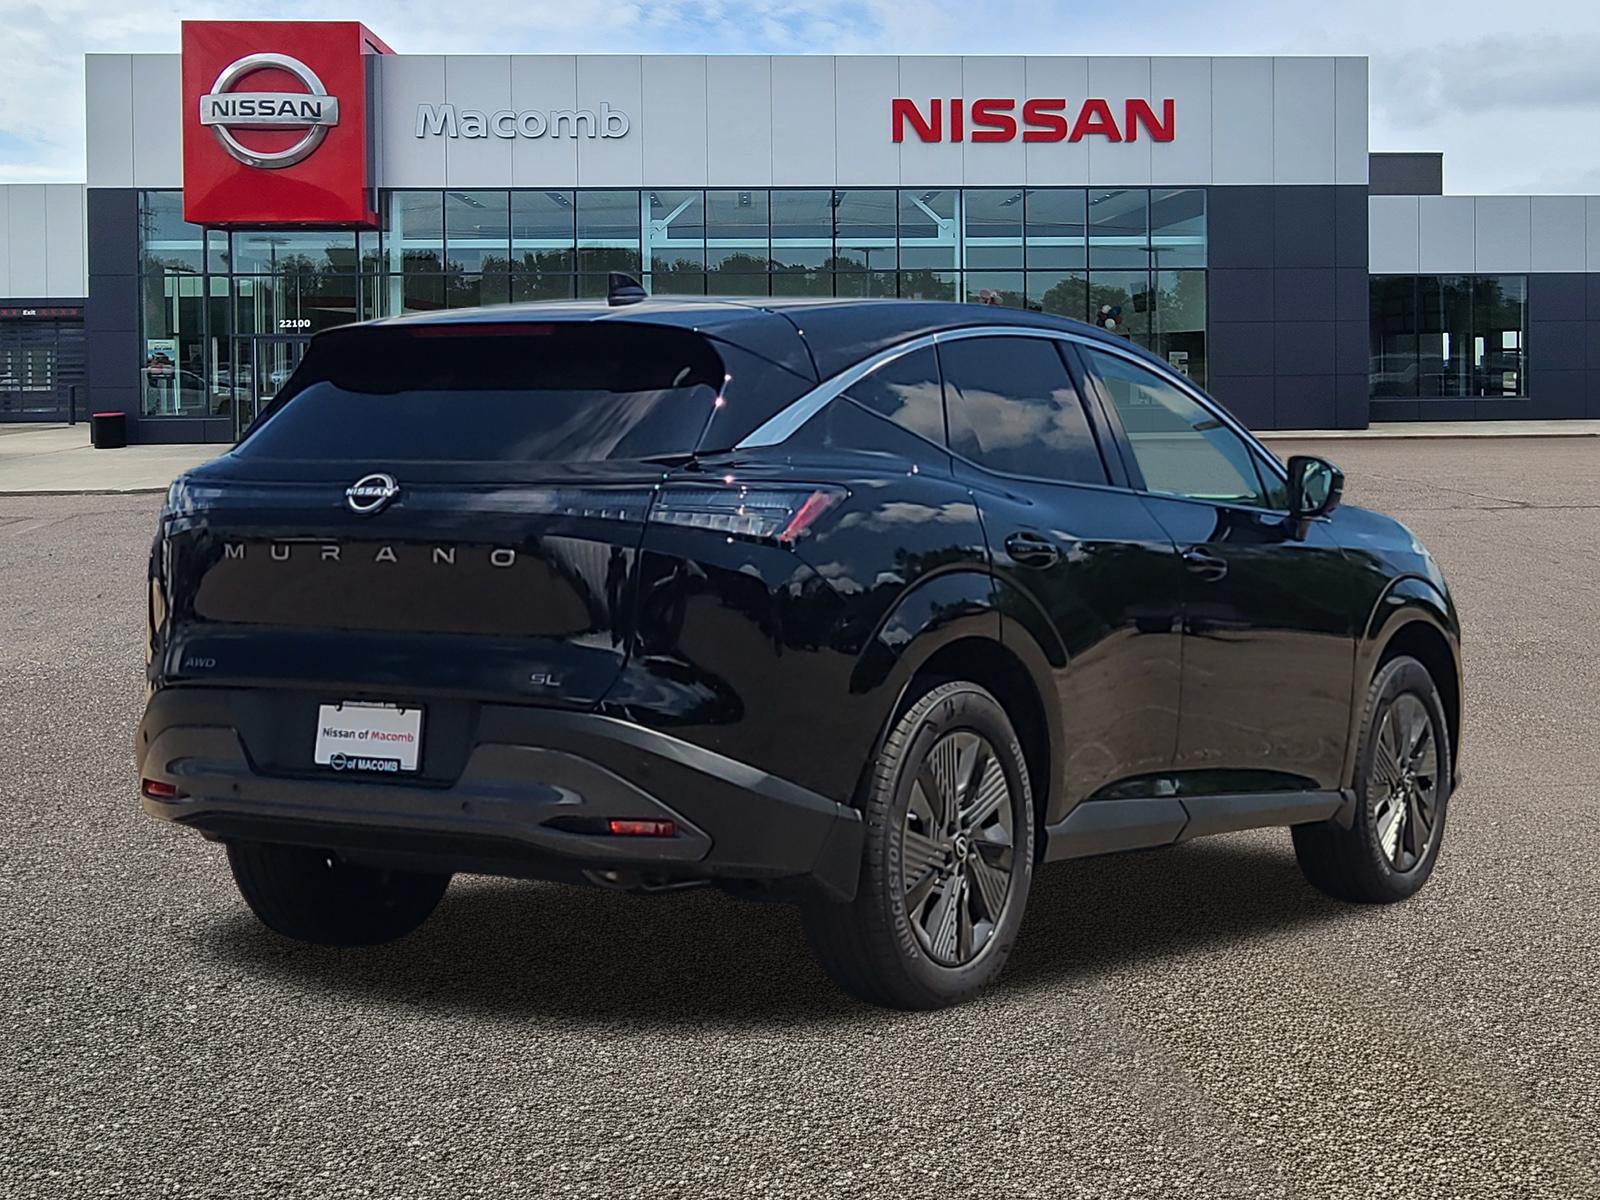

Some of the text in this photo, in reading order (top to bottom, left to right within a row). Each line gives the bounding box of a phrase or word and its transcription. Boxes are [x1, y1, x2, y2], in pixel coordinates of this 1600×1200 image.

[211, 99, 323, 119] NISSAN
[415, 102, 631, 140] Macomb
[892, 98, 1176, 143] NISSAN
[279, 318, 311, 329] 22100
[345, 487, 395, 497] NISSAN
[223, 543, 517, 568] MURANO
[185, 657, 216, 668] AWD
[530, 673, 560, 686] SL
[322, 728, 415, 743] Nissan of Macomb
[346, 759, 398, 772] of MACOMB
